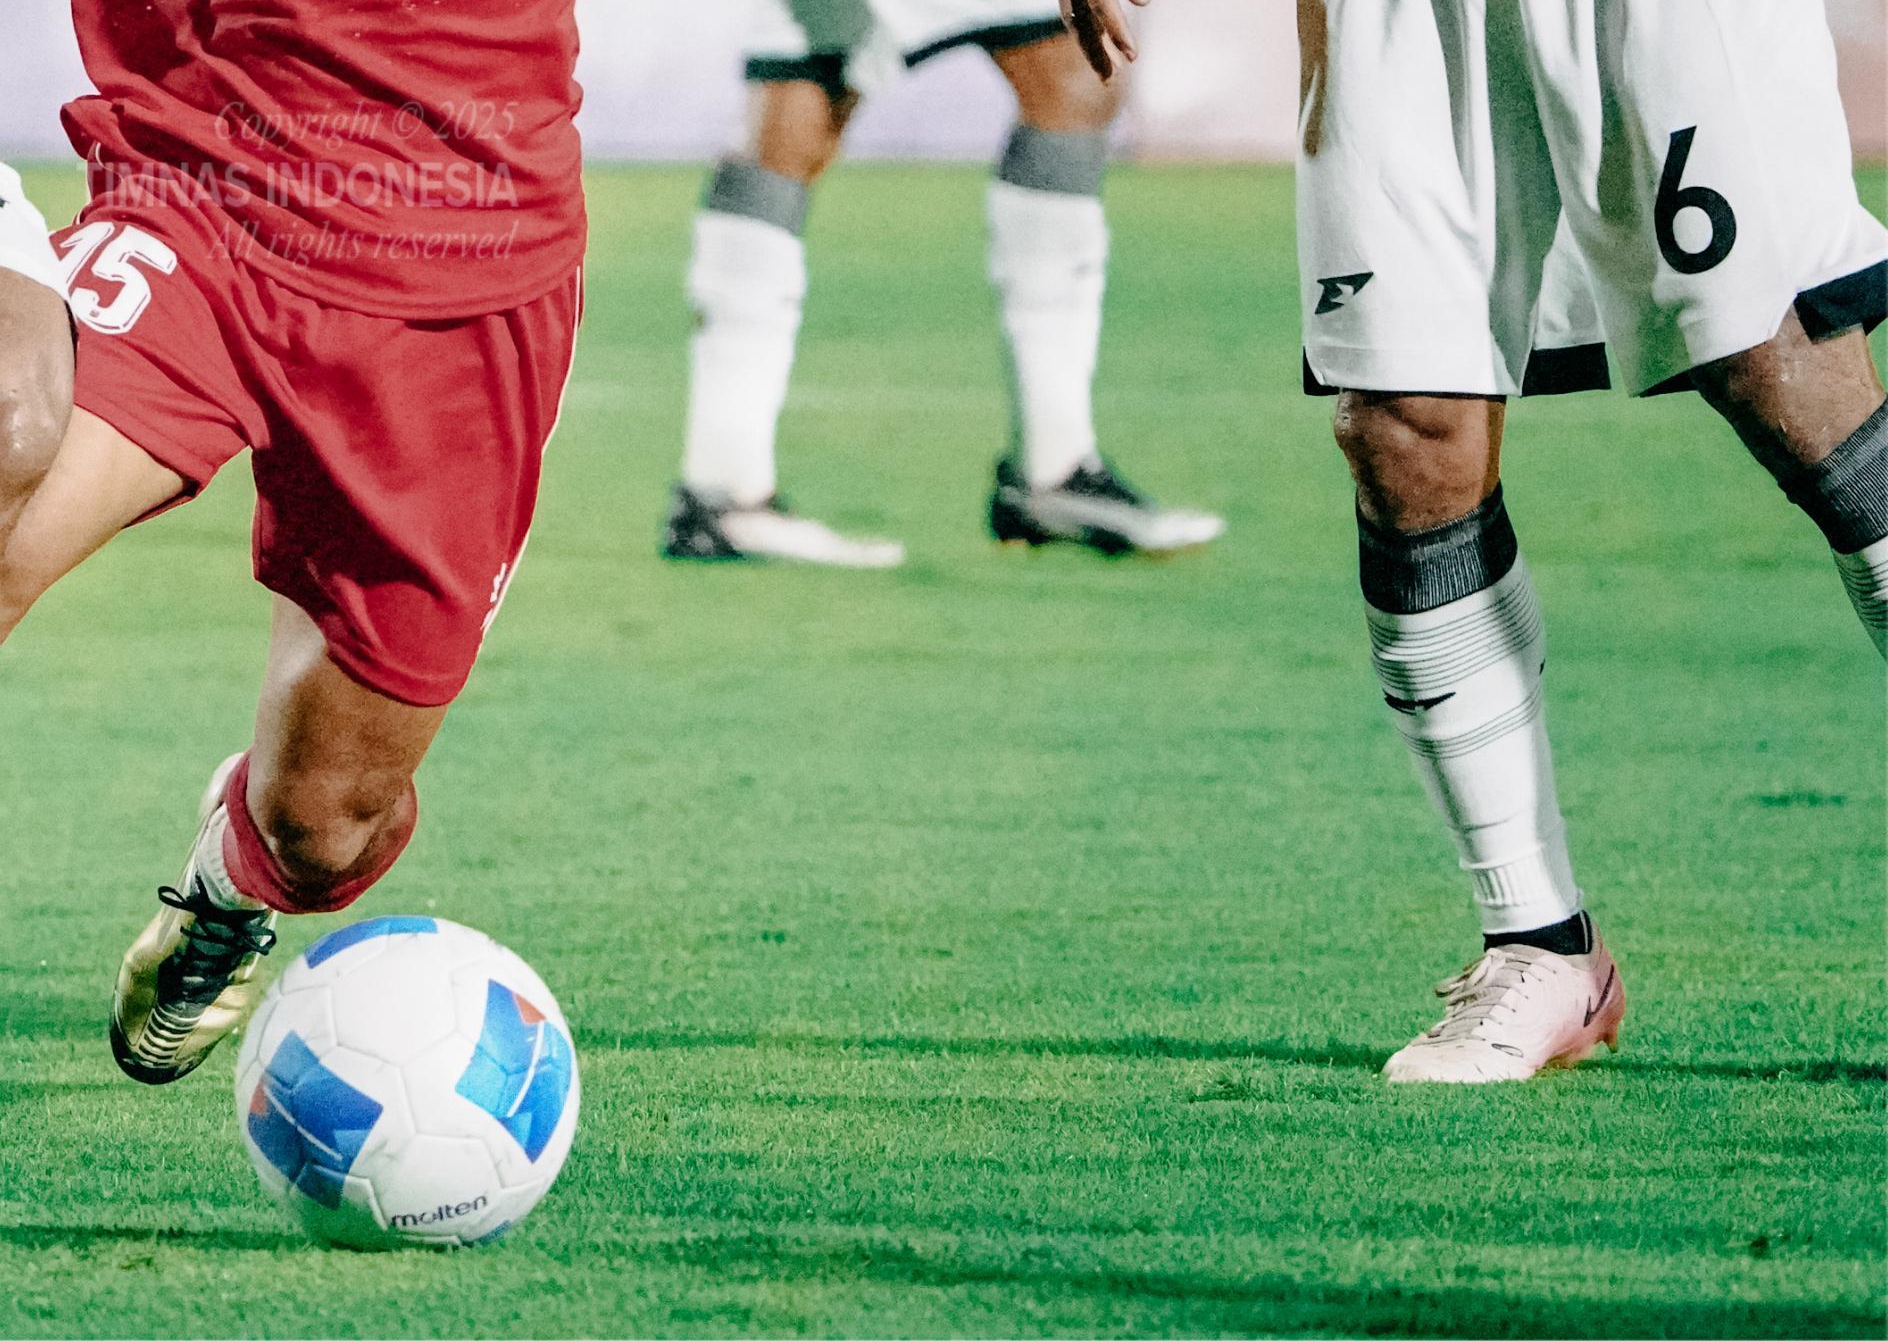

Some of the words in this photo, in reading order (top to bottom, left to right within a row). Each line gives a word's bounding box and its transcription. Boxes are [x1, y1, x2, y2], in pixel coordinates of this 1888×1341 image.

[1654, 125, 1737, 275] 6
[59, 221, 178, 335] 15
[391, 1194, 488, 1227] molten
